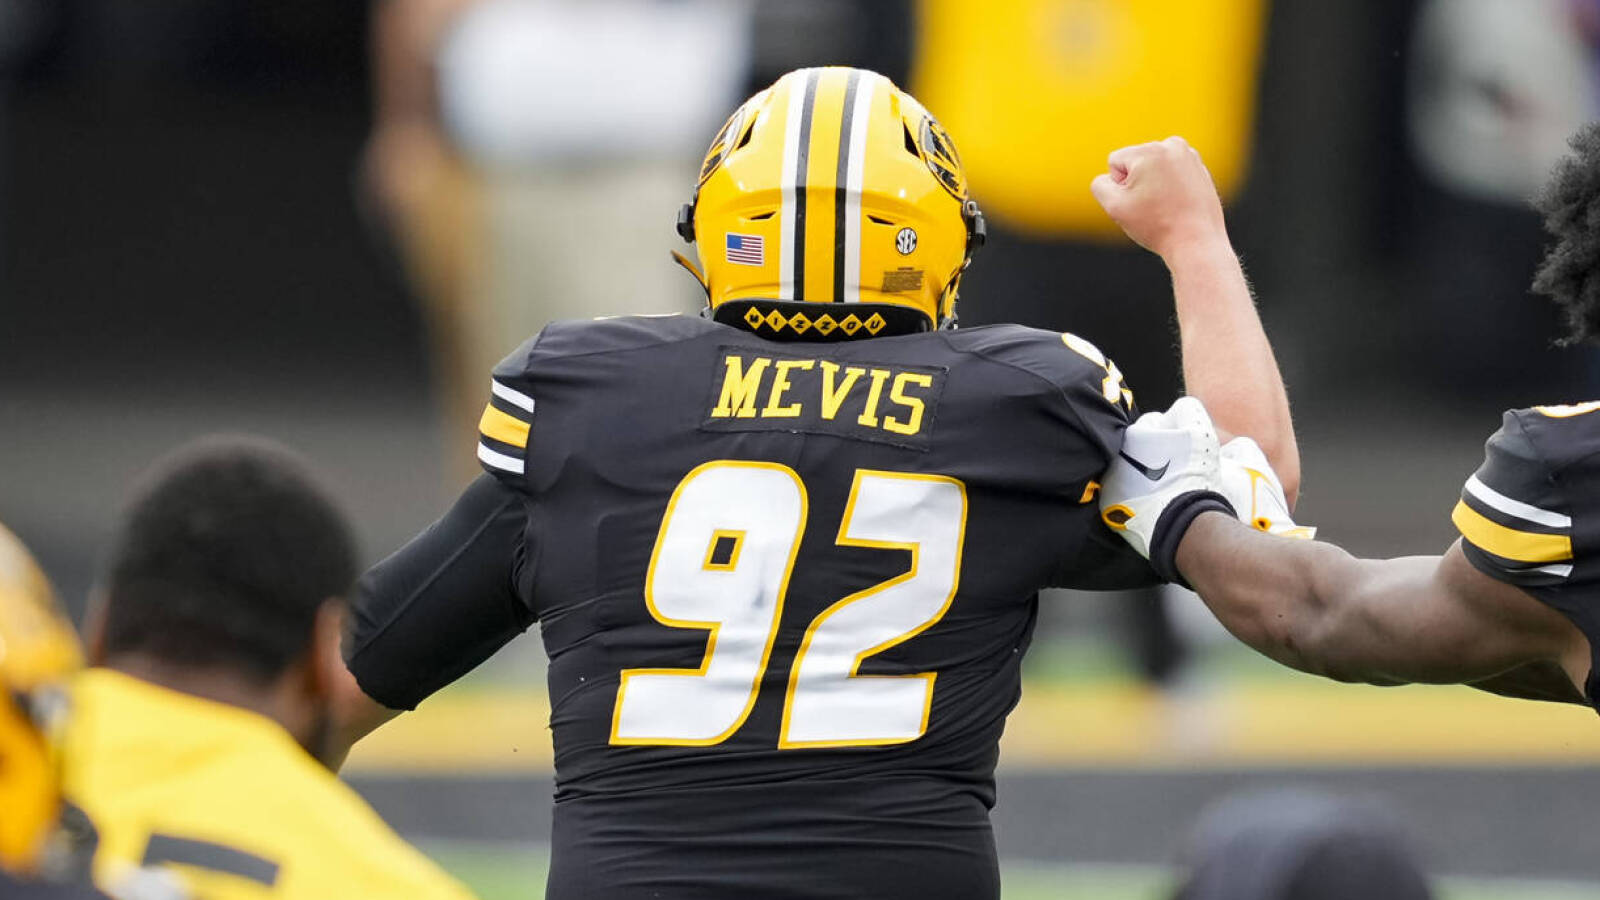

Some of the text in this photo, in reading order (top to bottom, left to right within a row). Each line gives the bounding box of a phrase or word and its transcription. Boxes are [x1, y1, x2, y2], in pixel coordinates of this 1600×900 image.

[896, 228, 917, 254] SEC
[747, 311, 883, 332] MIZZOU
[711, 356, 932, 435] MEVIS
[609, 459, 967, 750] 92
